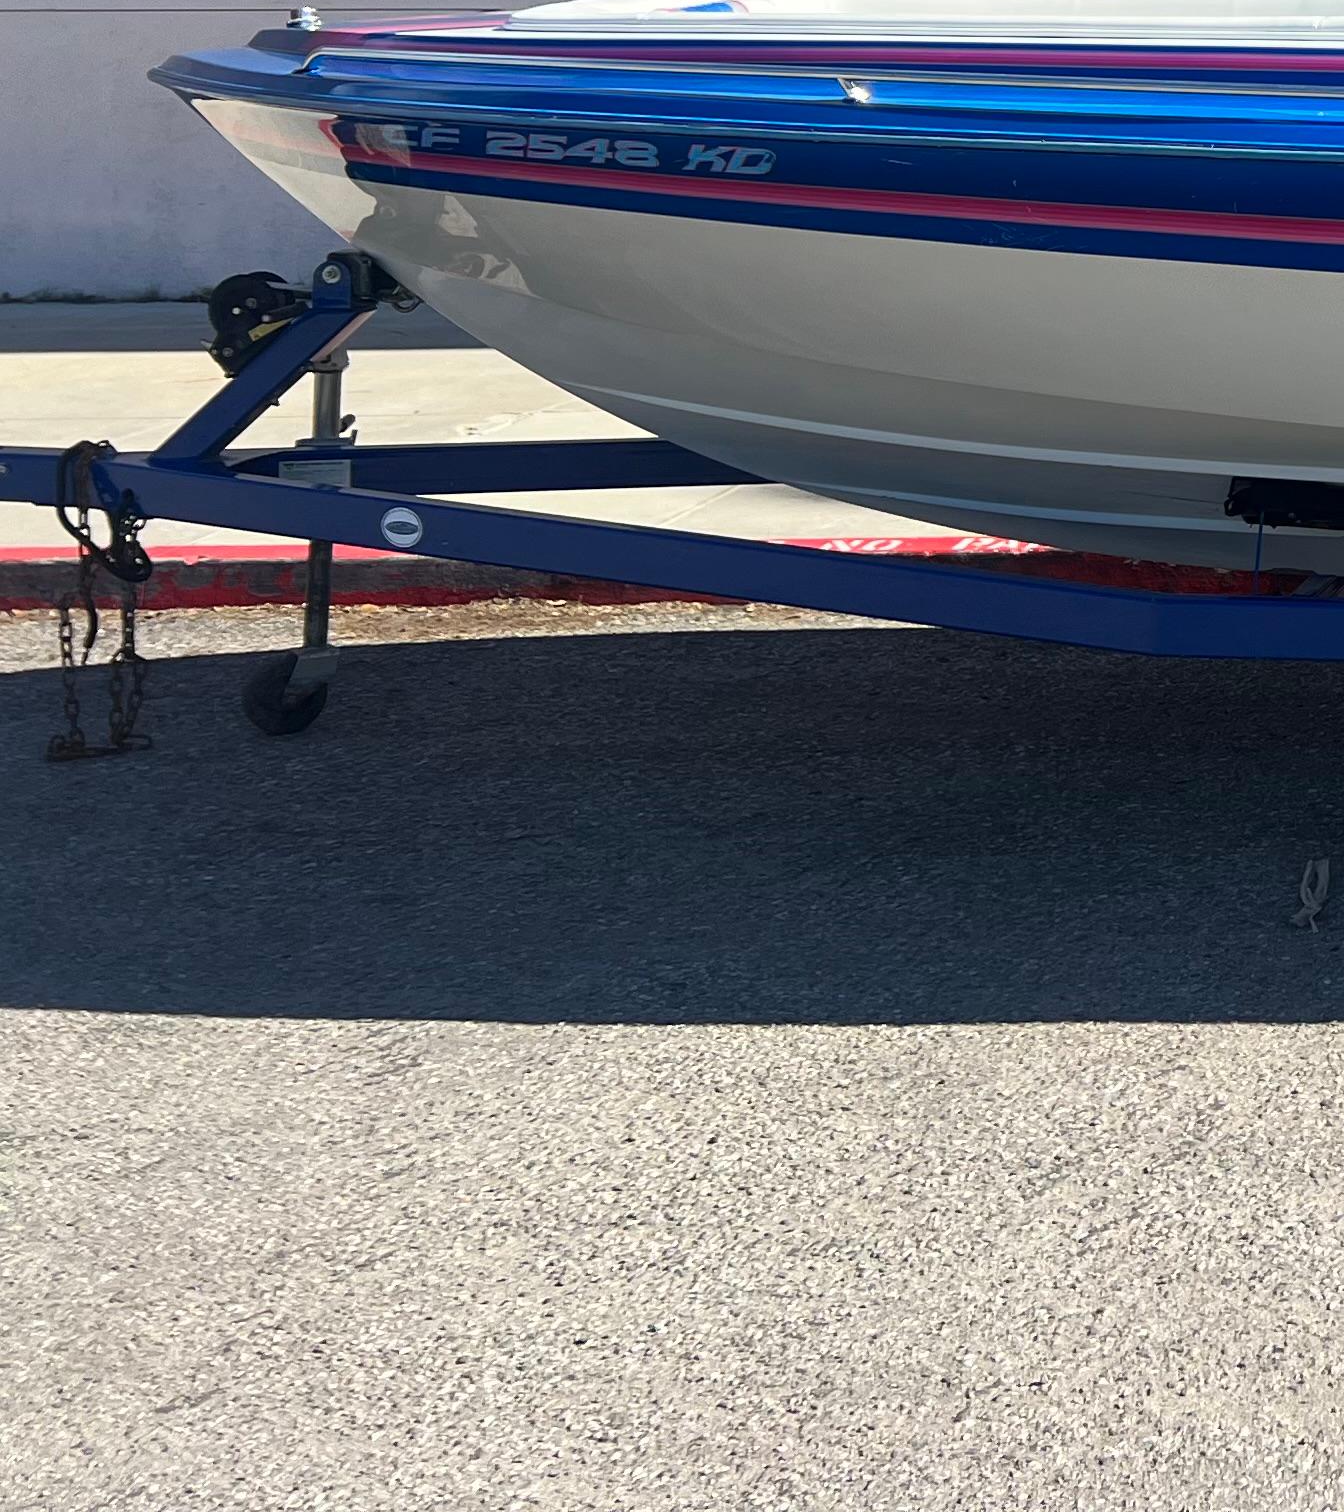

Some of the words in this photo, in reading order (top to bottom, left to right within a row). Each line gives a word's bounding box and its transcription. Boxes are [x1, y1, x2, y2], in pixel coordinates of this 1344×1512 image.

[382, 124, 461, 150] CF
[485, 129, 660, 168] 2548
[682, 143, 777, 175] KD
